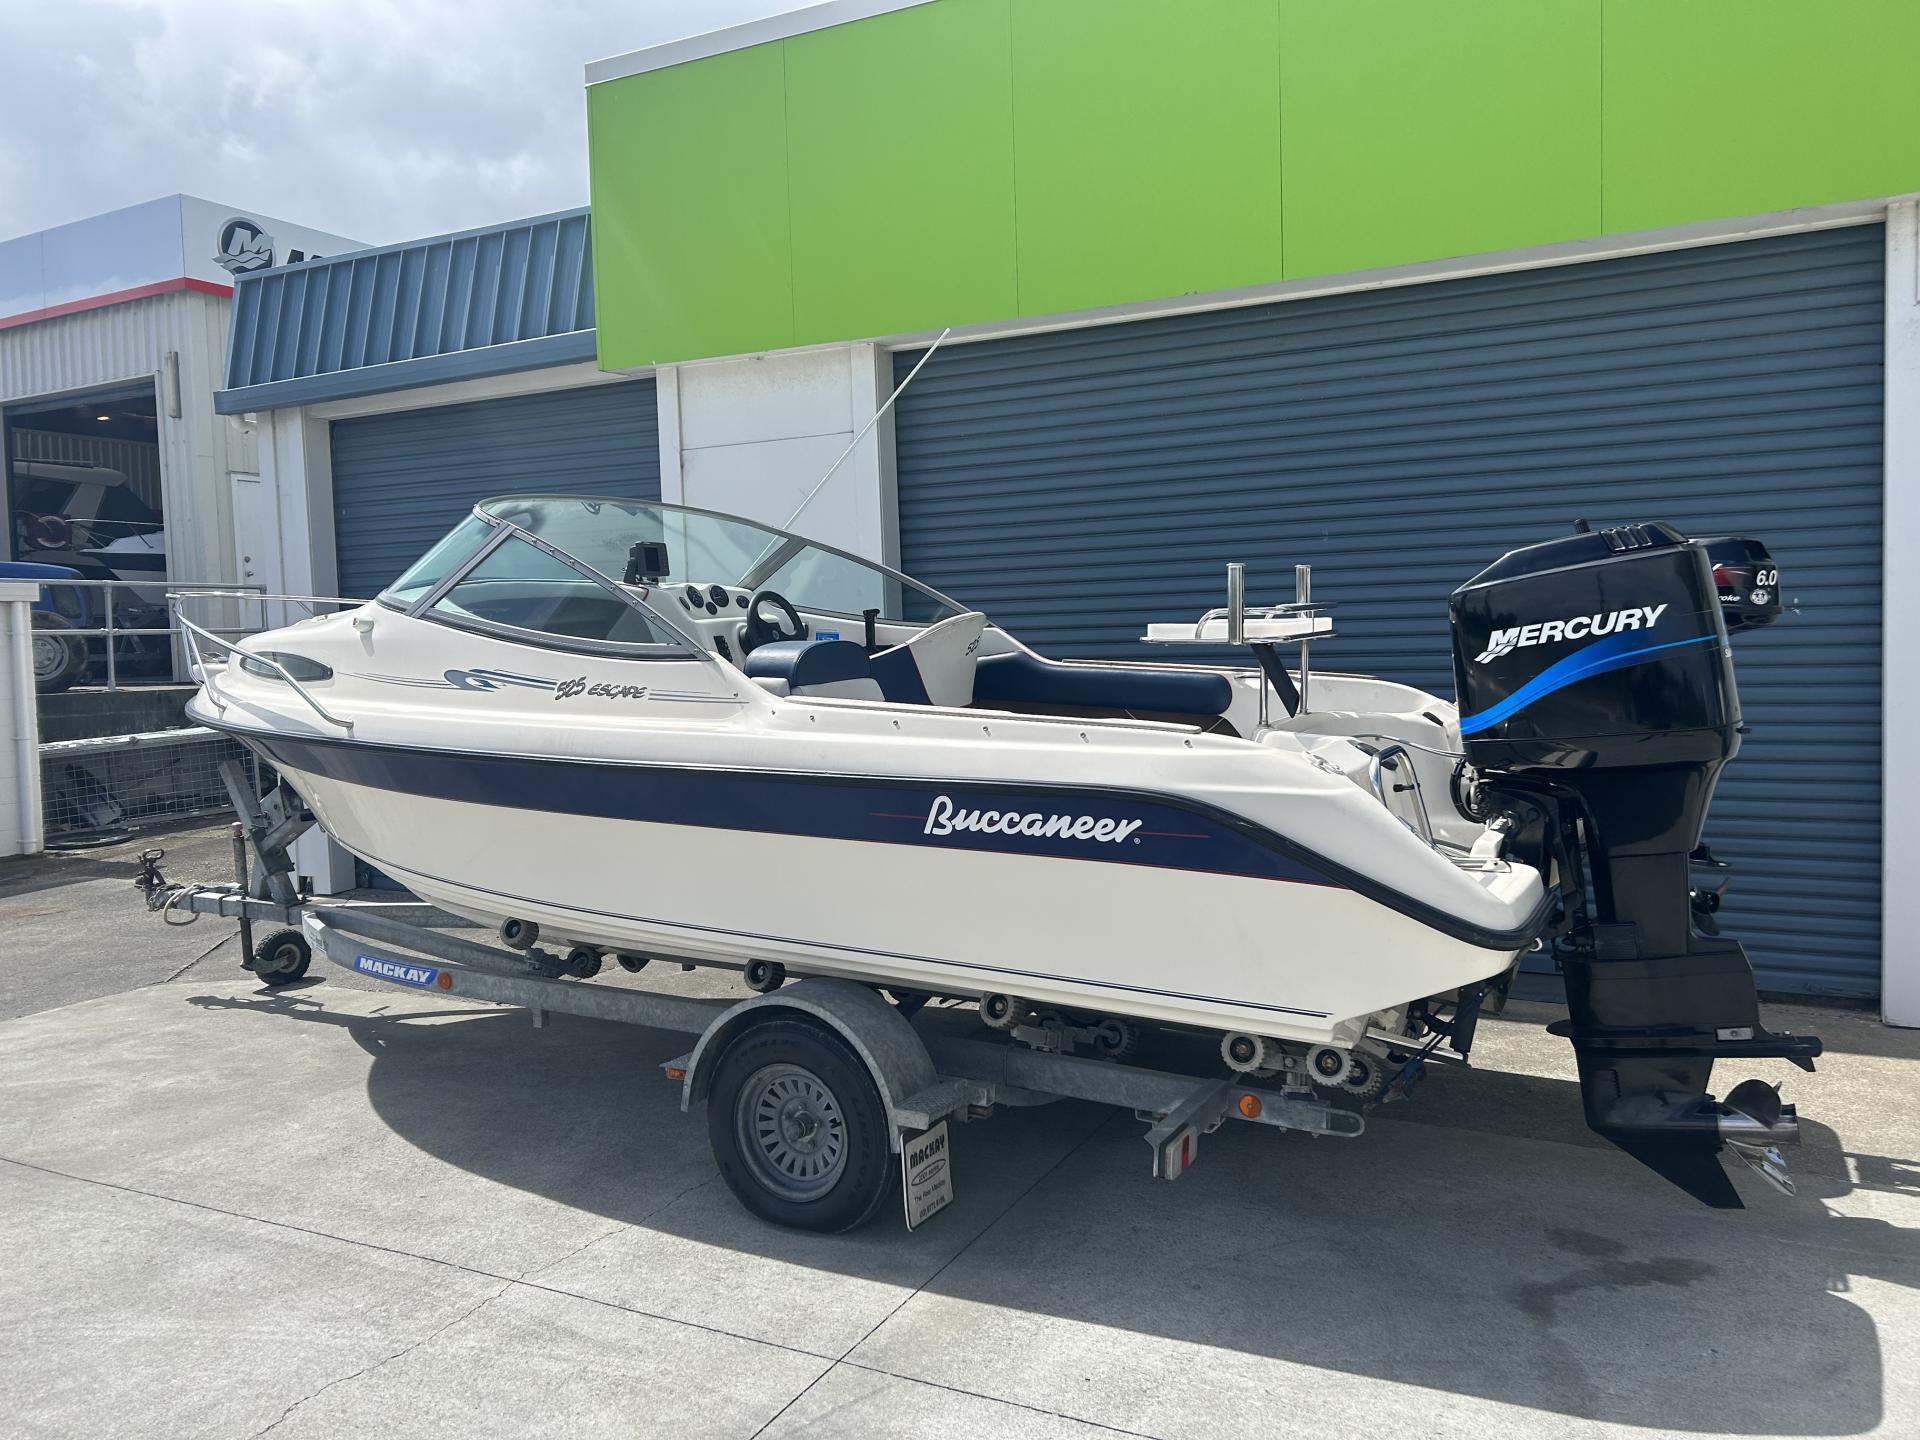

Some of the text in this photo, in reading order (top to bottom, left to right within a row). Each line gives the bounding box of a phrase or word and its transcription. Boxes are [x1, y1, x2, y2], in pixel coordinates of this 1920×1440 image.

[1756, 569, 1777, 586] 6.0
[1718, 594, 1741, 602] roke
[1473, 603, 1668, 664] MERCURY
[555, 676, 648, 701] 525 ESCAPE
[924, 795, 1142, 843] Buccaneer
[359, 957, 432, 983] MACKAY
[909, 1134, 945, 1169] MACKAY
